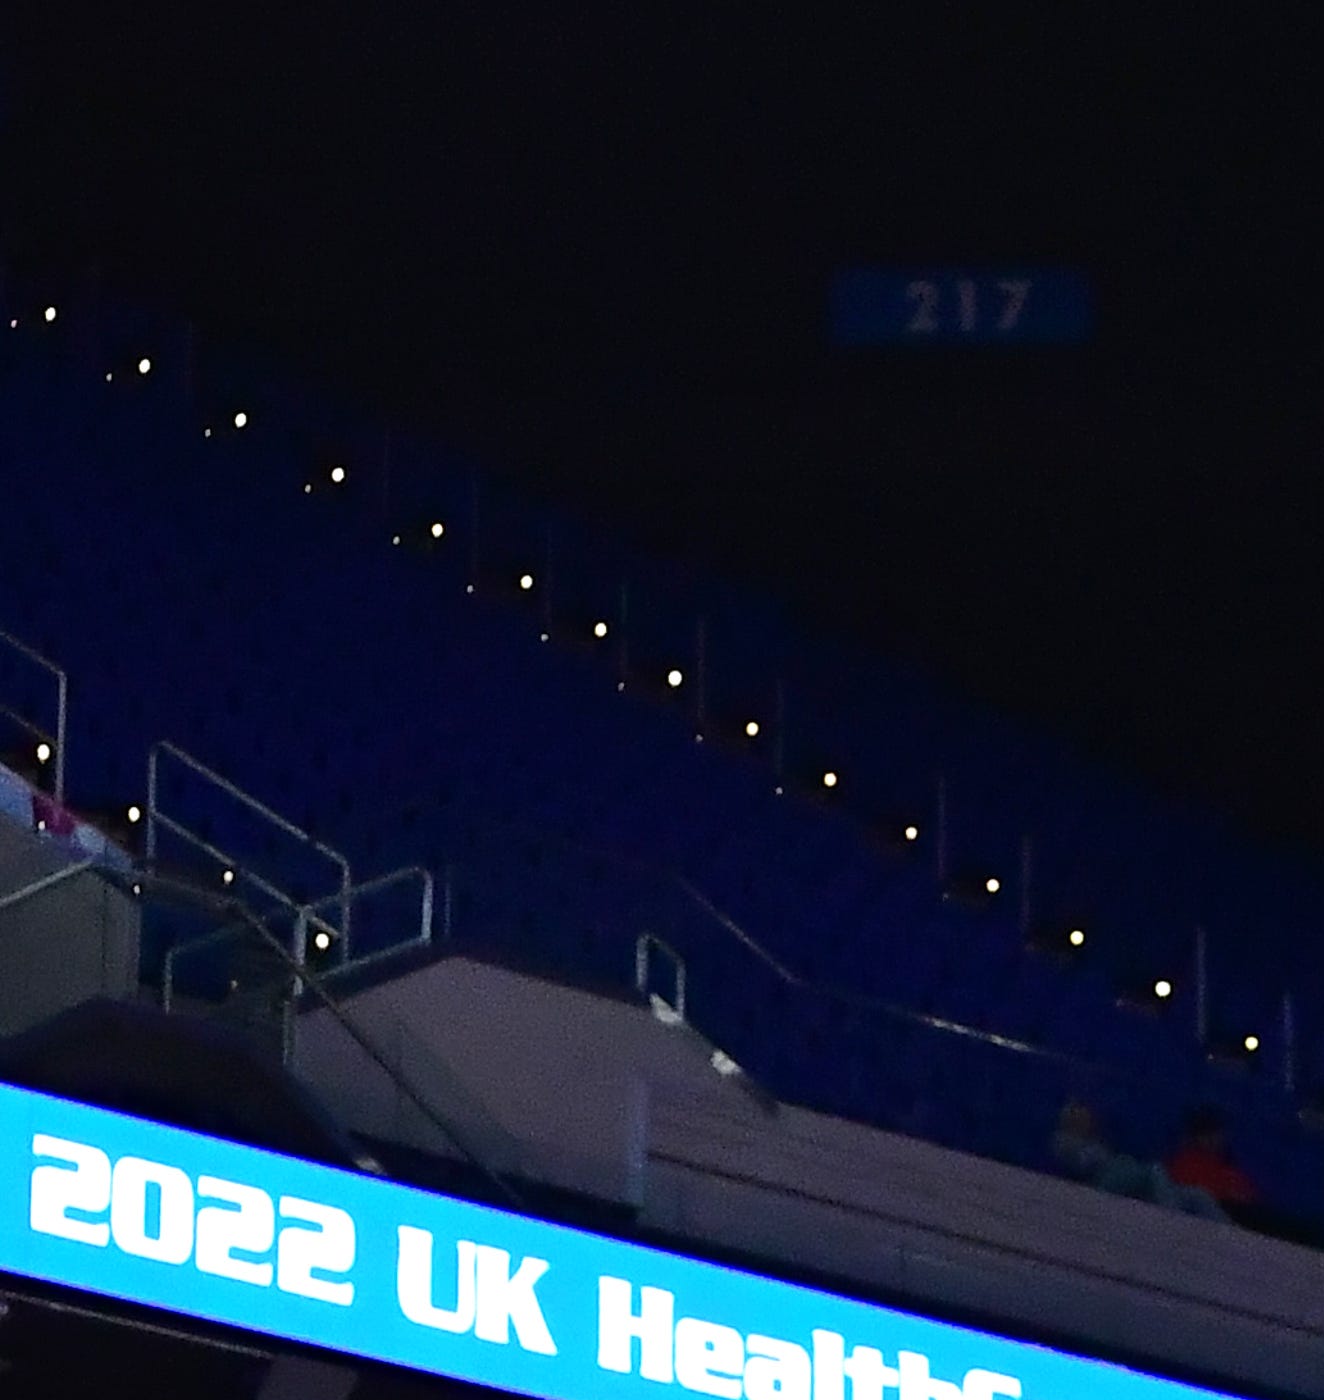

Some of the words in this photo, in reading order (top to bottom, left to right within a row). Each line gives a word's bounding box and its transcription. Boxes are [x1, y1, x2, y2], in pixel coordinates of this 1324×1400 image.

[904, 279, 1032, 333] 217
[30, 1133, 356, 1306] 2022
[397, 1225, 557, 1355] UK
